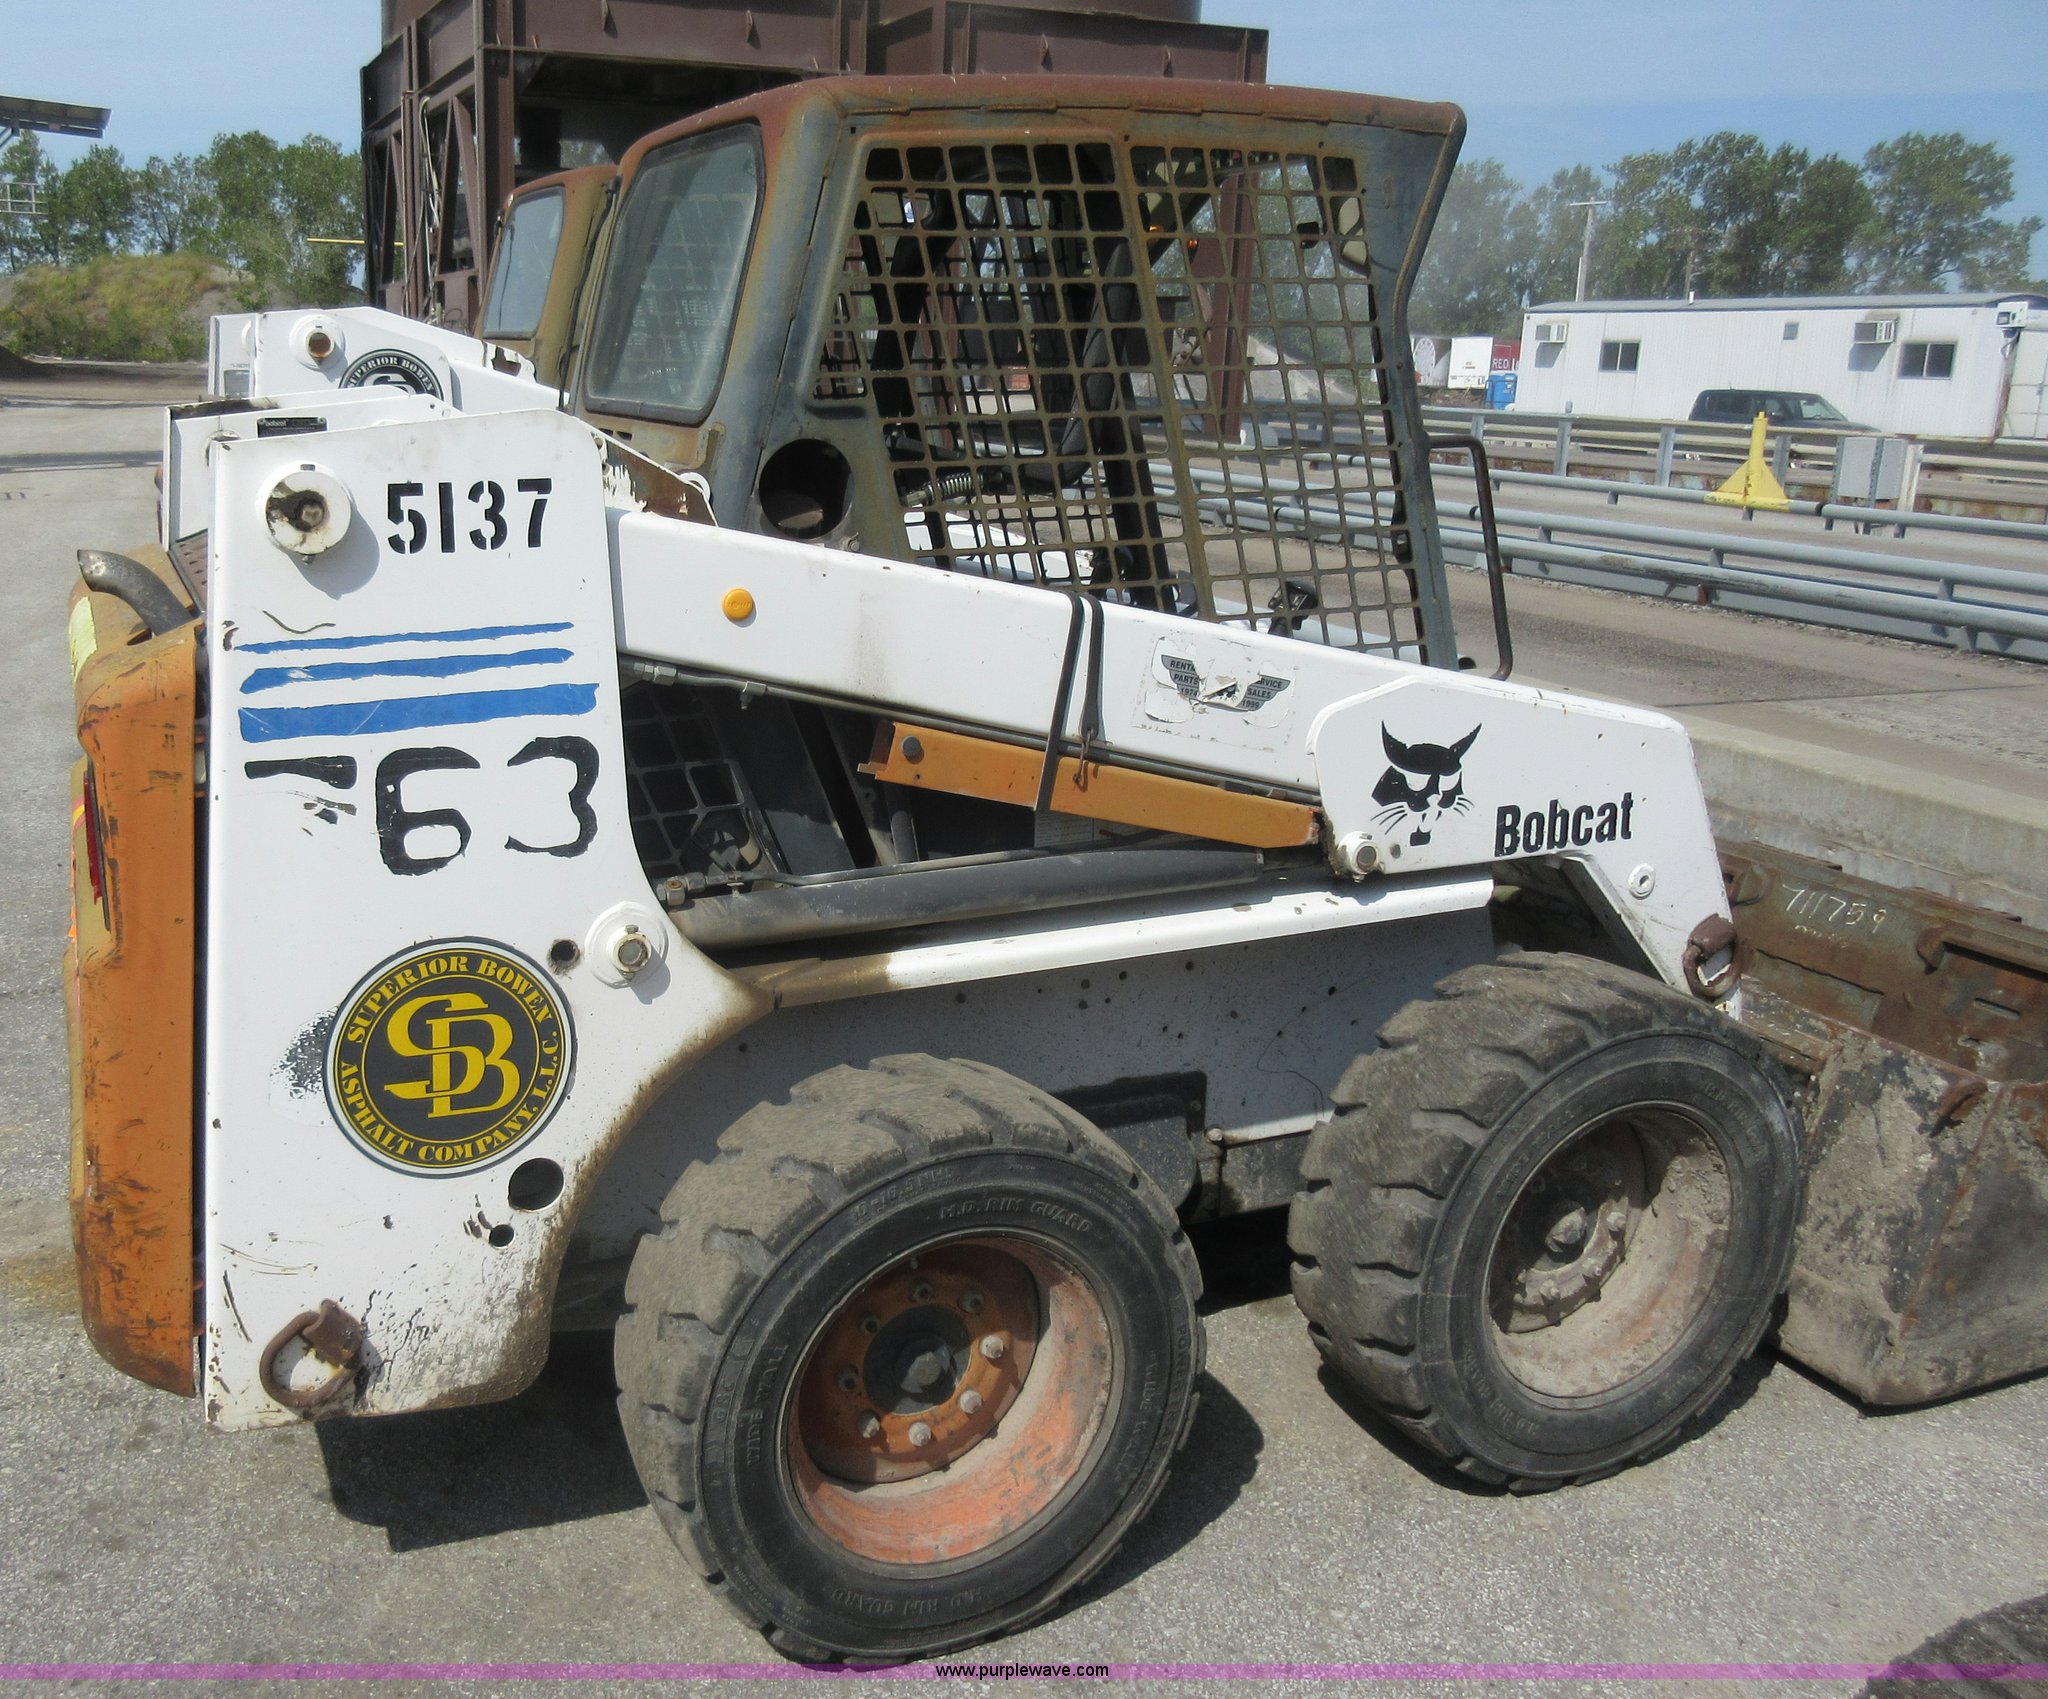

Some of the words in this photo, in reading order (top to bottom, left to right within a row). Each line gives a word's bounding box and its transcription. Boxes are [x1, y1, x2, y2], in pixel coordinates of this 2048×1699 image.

[387, 478, 552, 554] 5137
[1247, 687, 1272, 699] SALES
[1494, 792, 1634, 857] Bobcat
[347, 955, 470, 1044] SUPERIOR
[476, 958, 553, 1024] BOWEN
[341, 1060, 414, 1156] ASPHALT
[1030, 1201, 1093, 1232] GUARD
